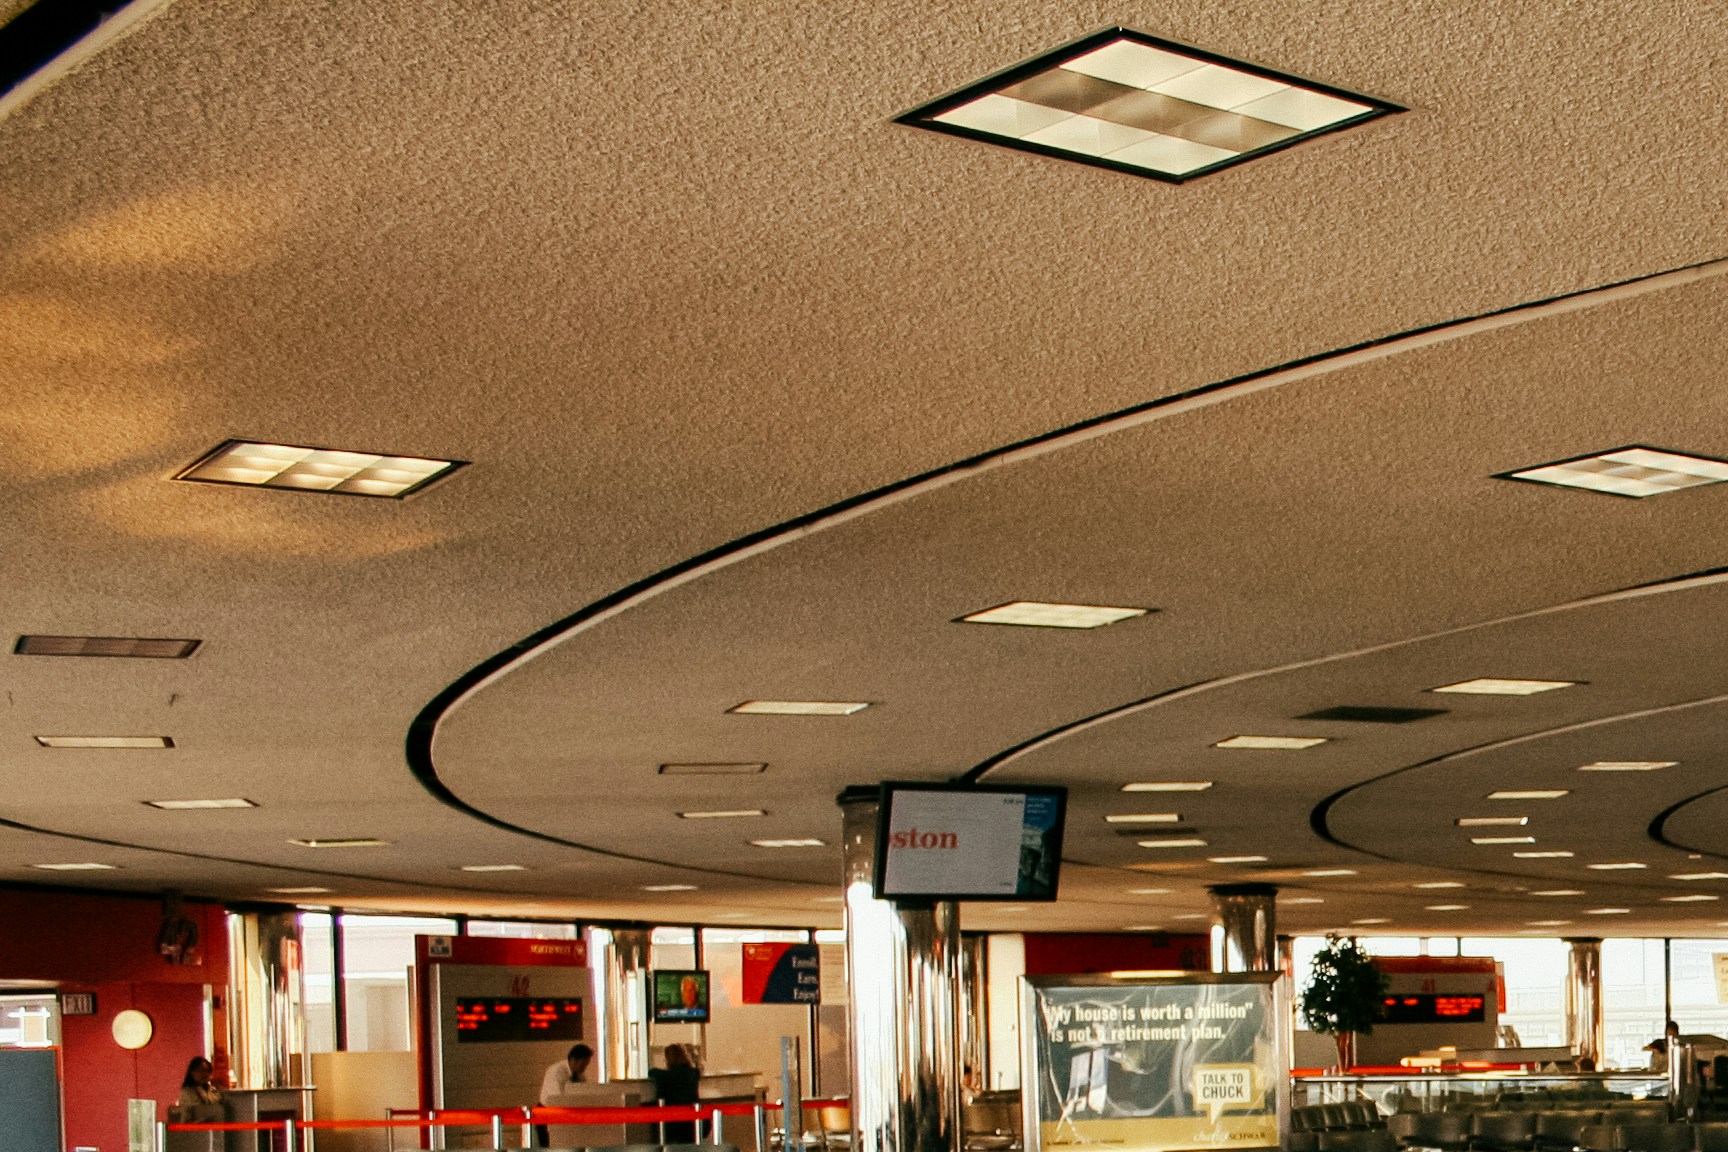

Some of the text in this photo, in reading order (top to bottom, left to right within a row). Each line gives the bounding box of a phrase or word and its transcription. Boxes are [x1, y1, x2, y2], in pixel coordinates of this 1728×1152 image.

[889, 827, 958, 849] ston
[1075, 1005, 1117, 1022] house
[1122, 1005, 1135, 1021] is
[1140, 1004, 1182, 1021] worth
[1184, 1006, 1193, 1019] a
[1198, 1002, 1254, 1020] million"
[1050, 1028, 1064, 1043] is
[1068, 1027, 1091, 1043] not
[1111, 1025, 1186, 1041] retirement
[1192, 1024, 1227, 1043] plan.
[1201, 1073, 1244, 1085] TALK TO
[1202, 1086, 1244, 1099] CHUCK
